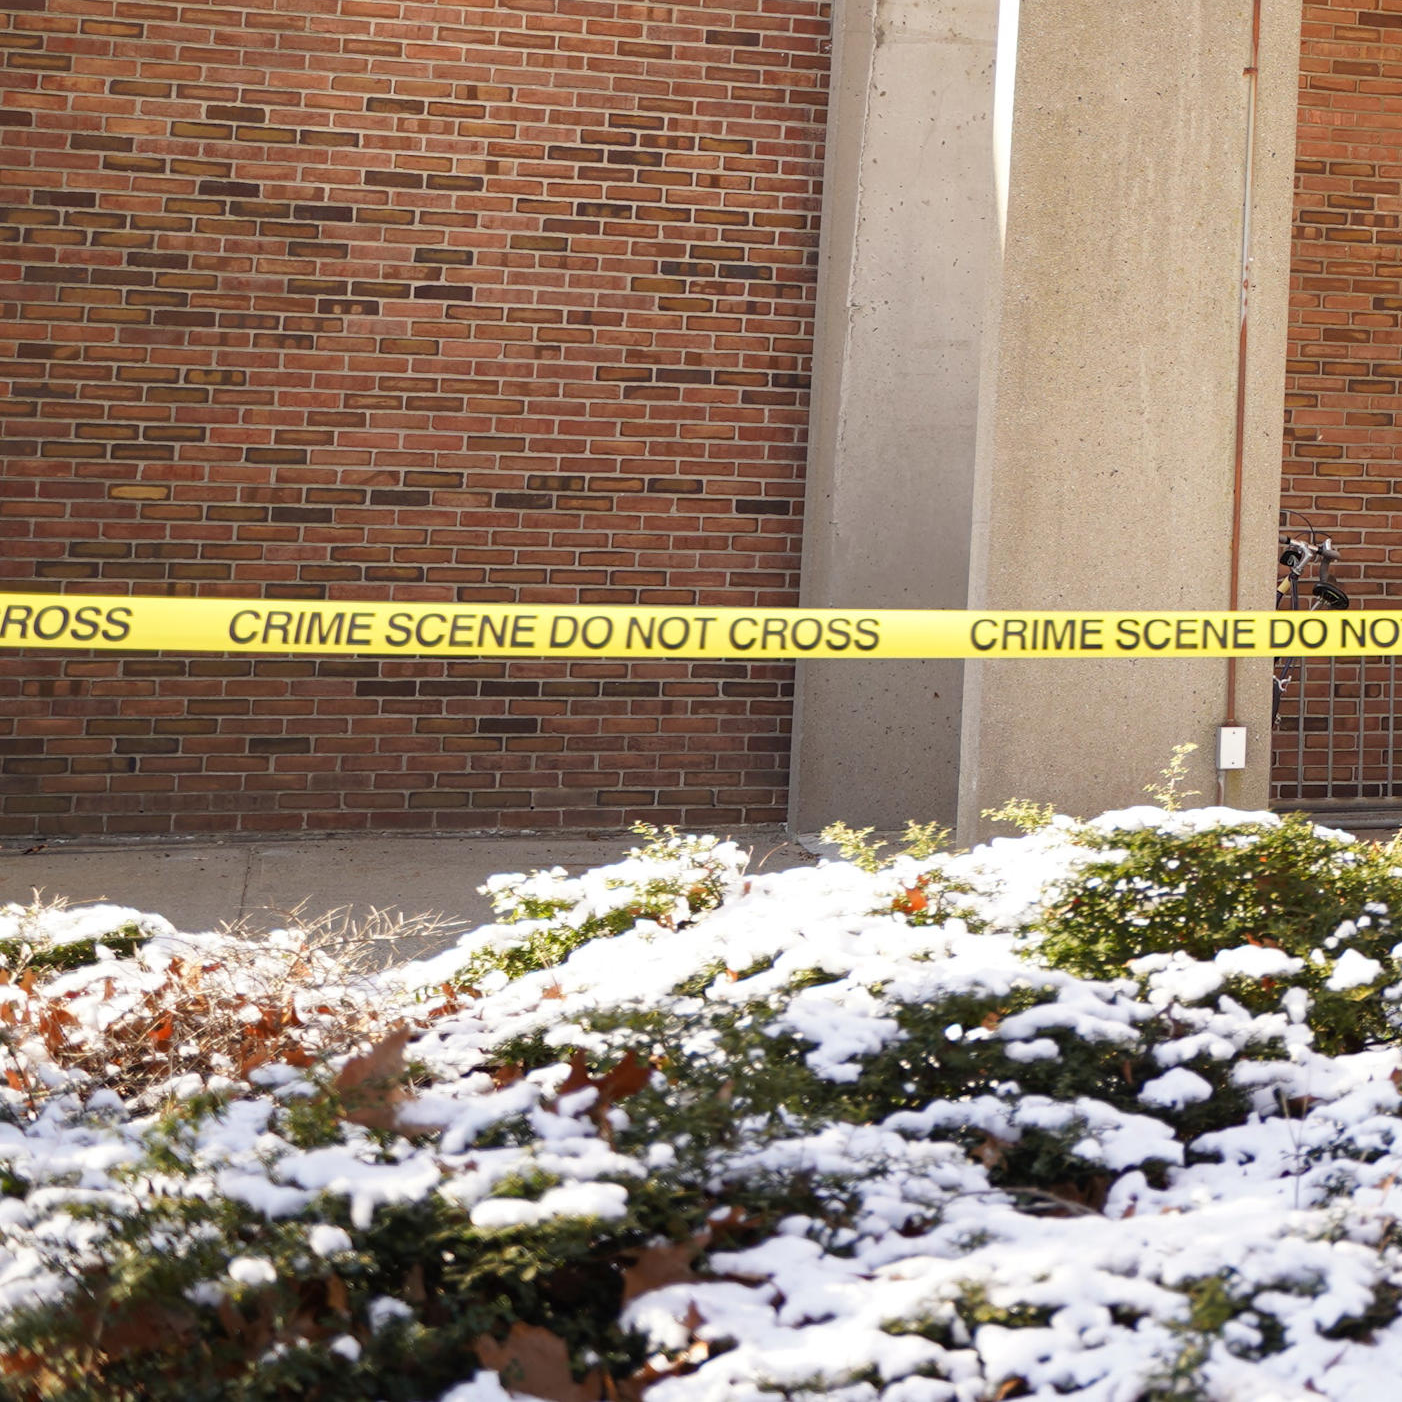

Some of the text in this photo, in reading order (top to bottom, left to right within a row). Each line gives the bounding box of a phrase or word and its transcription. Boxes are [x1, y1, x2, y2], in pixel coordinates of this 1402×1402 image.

[0, 605, 133, 642] ROSS
[229, 610, 879, 651] CRIME SCENE DO NOT CROSS
[971, 619, 1103, 651] CRIME
[1116, 619, 1256, 651] SCENE
[1269, 618, 1328, 649] DO
